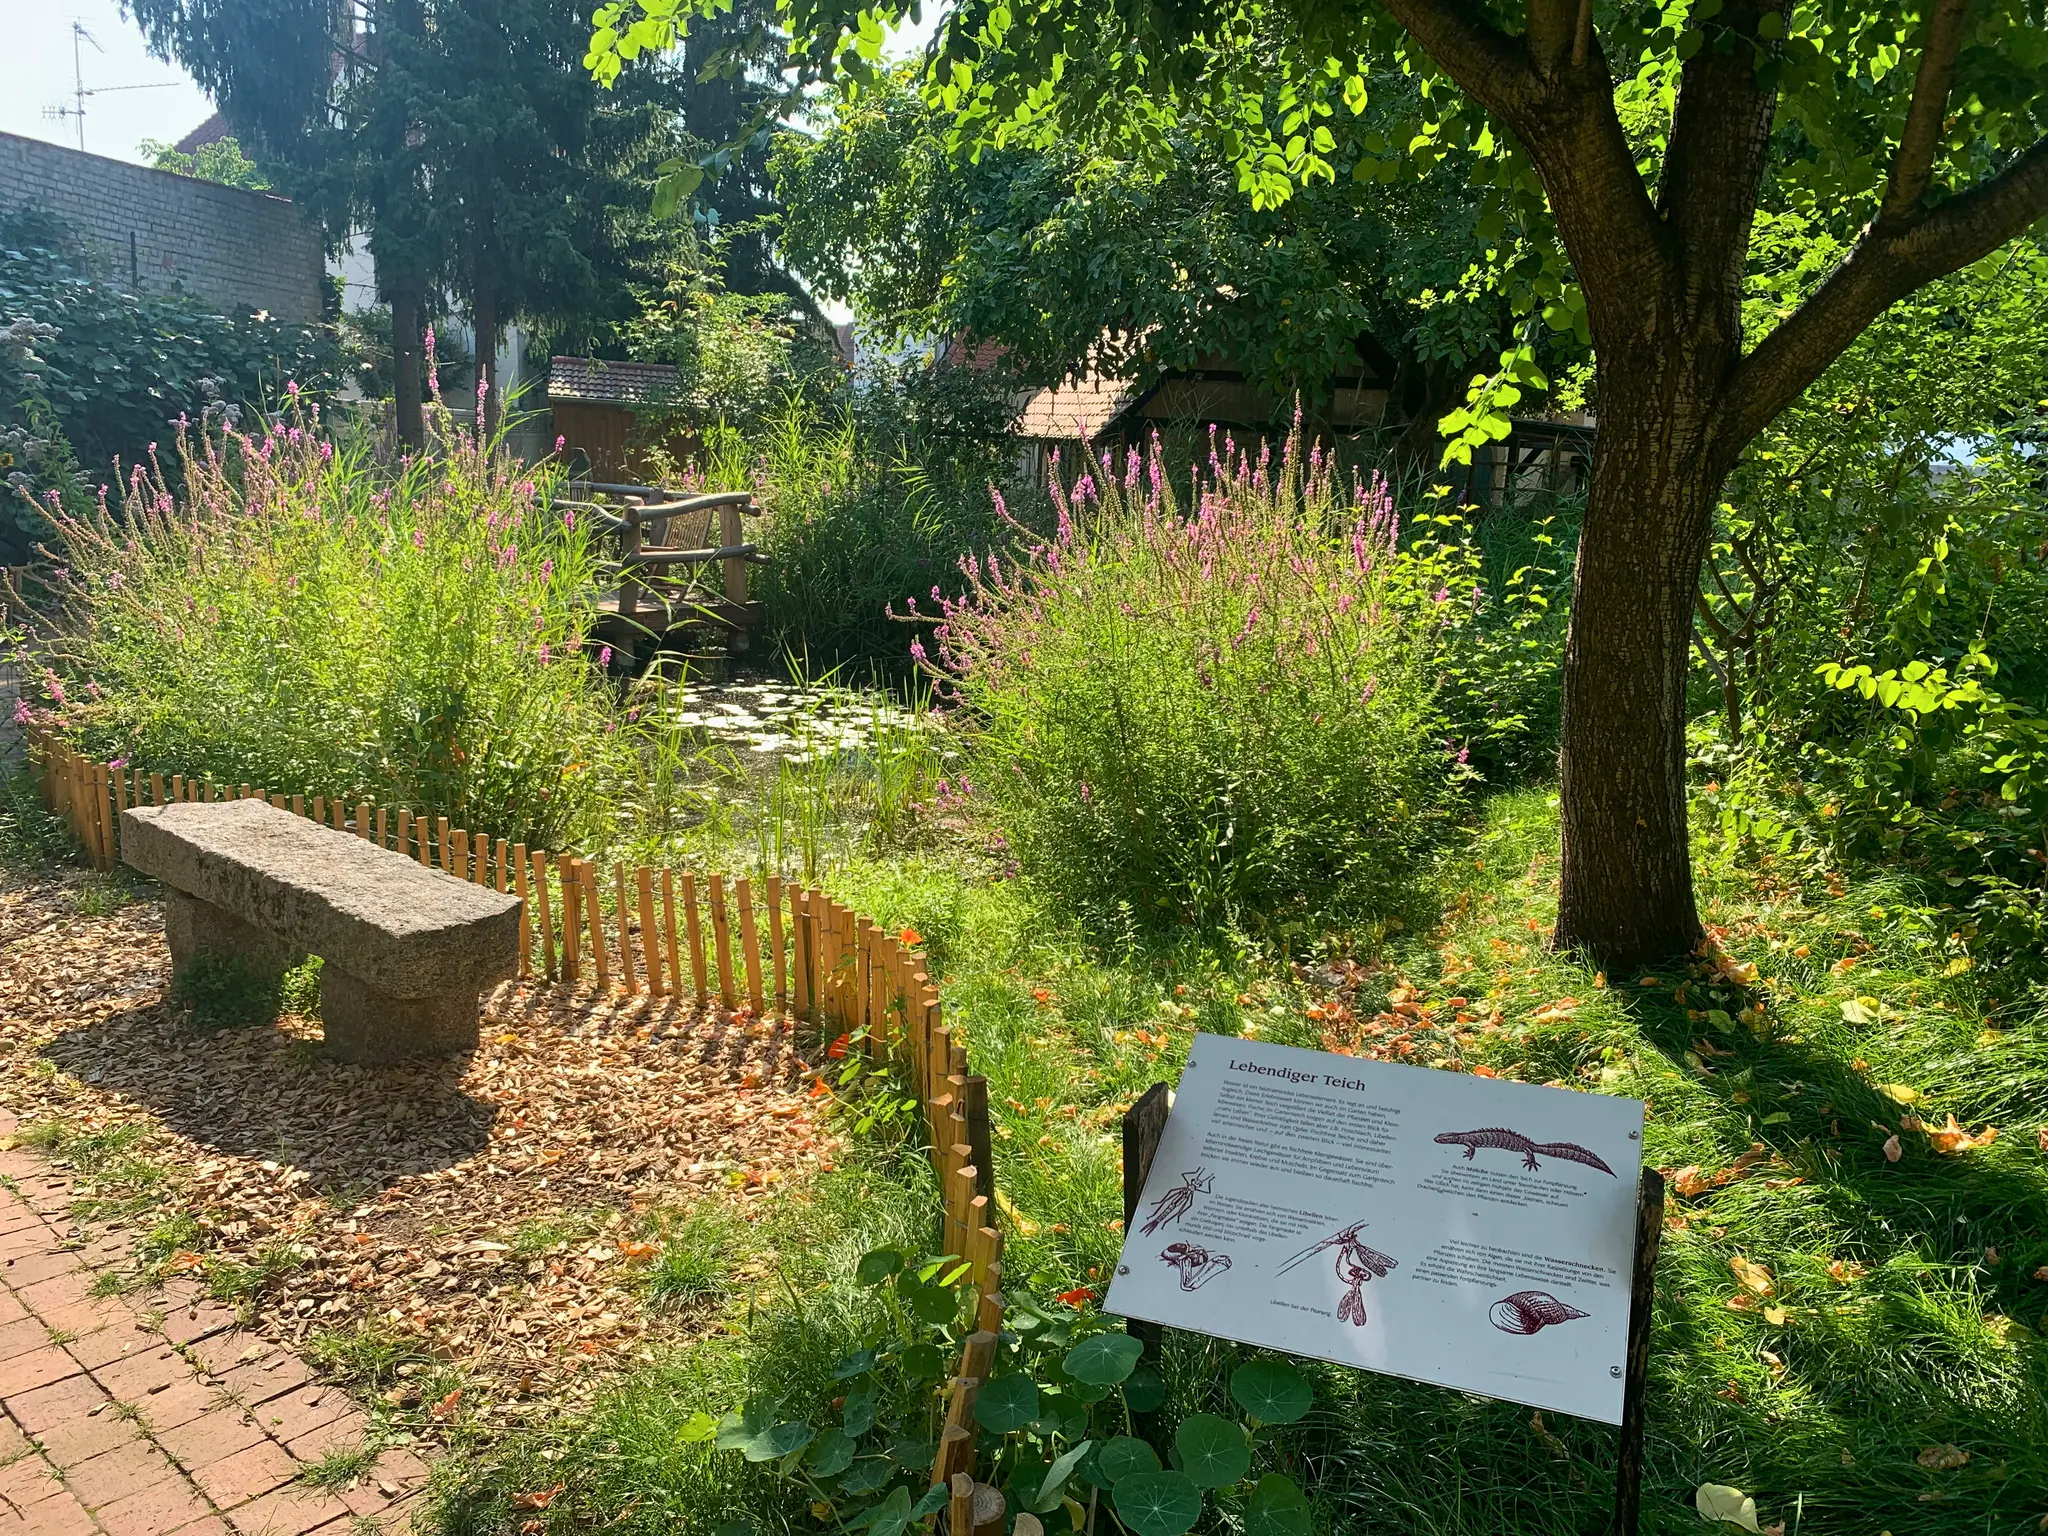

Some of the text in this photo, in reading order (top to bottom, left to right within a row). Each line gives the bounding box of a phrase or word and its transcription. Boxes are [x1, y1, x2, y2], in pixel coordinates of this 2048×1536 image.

[1229, 1060, 1367, 1091] Lebendiger Teich
[1299, 1210, 1324, 1219] Libellen
[1545, 1256, 1607, 1272] Wasserschnecken.
